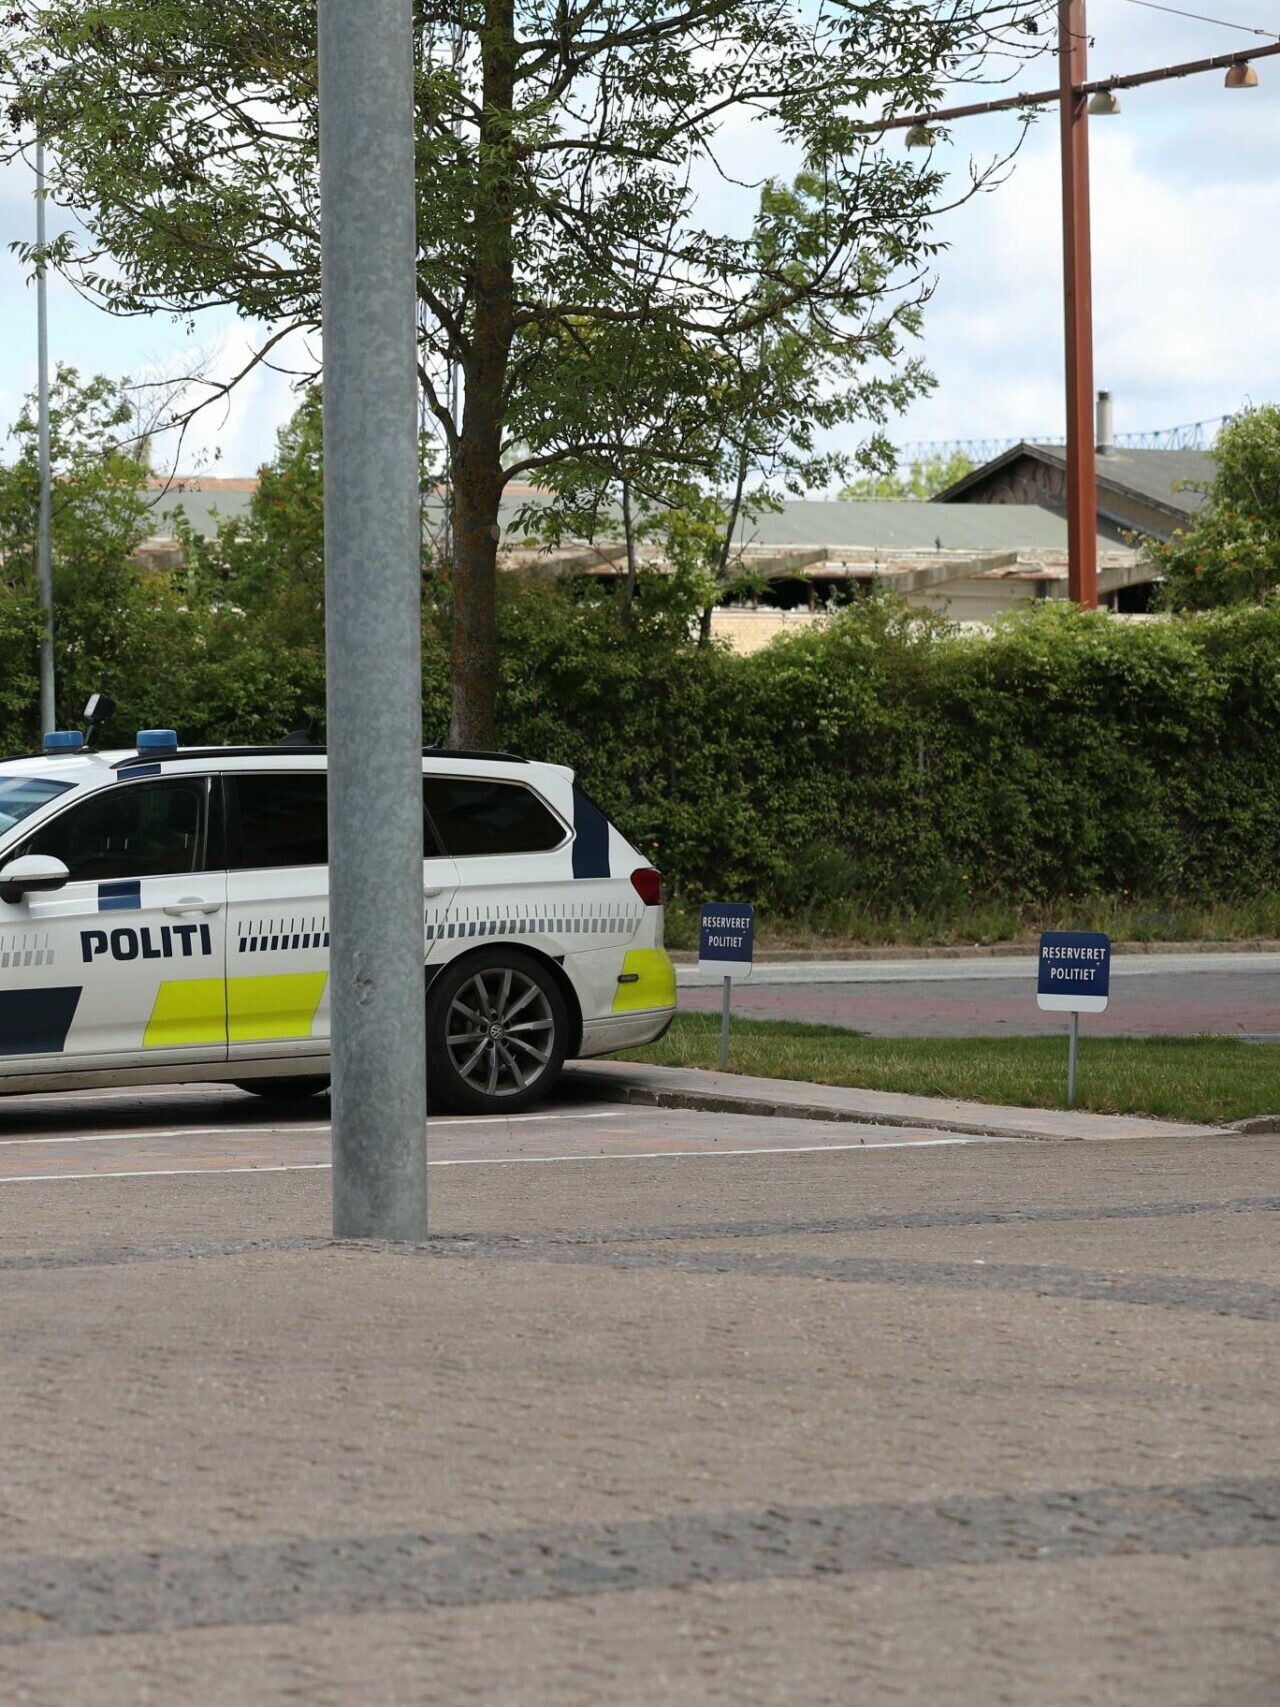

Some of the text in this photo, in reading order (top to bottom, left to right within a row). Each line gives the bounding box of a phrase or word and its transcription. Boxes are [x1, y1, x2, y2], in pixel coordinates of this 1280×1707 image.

[702, 916, 751, 929] RESERVERET
[80, 923, 212, 962] POLITI
[708, 935, 743, 948] POLITIET
[1042, 946, 1106, 960] RESERVERET
[1050, 967, 1096, 981] POLITIET
